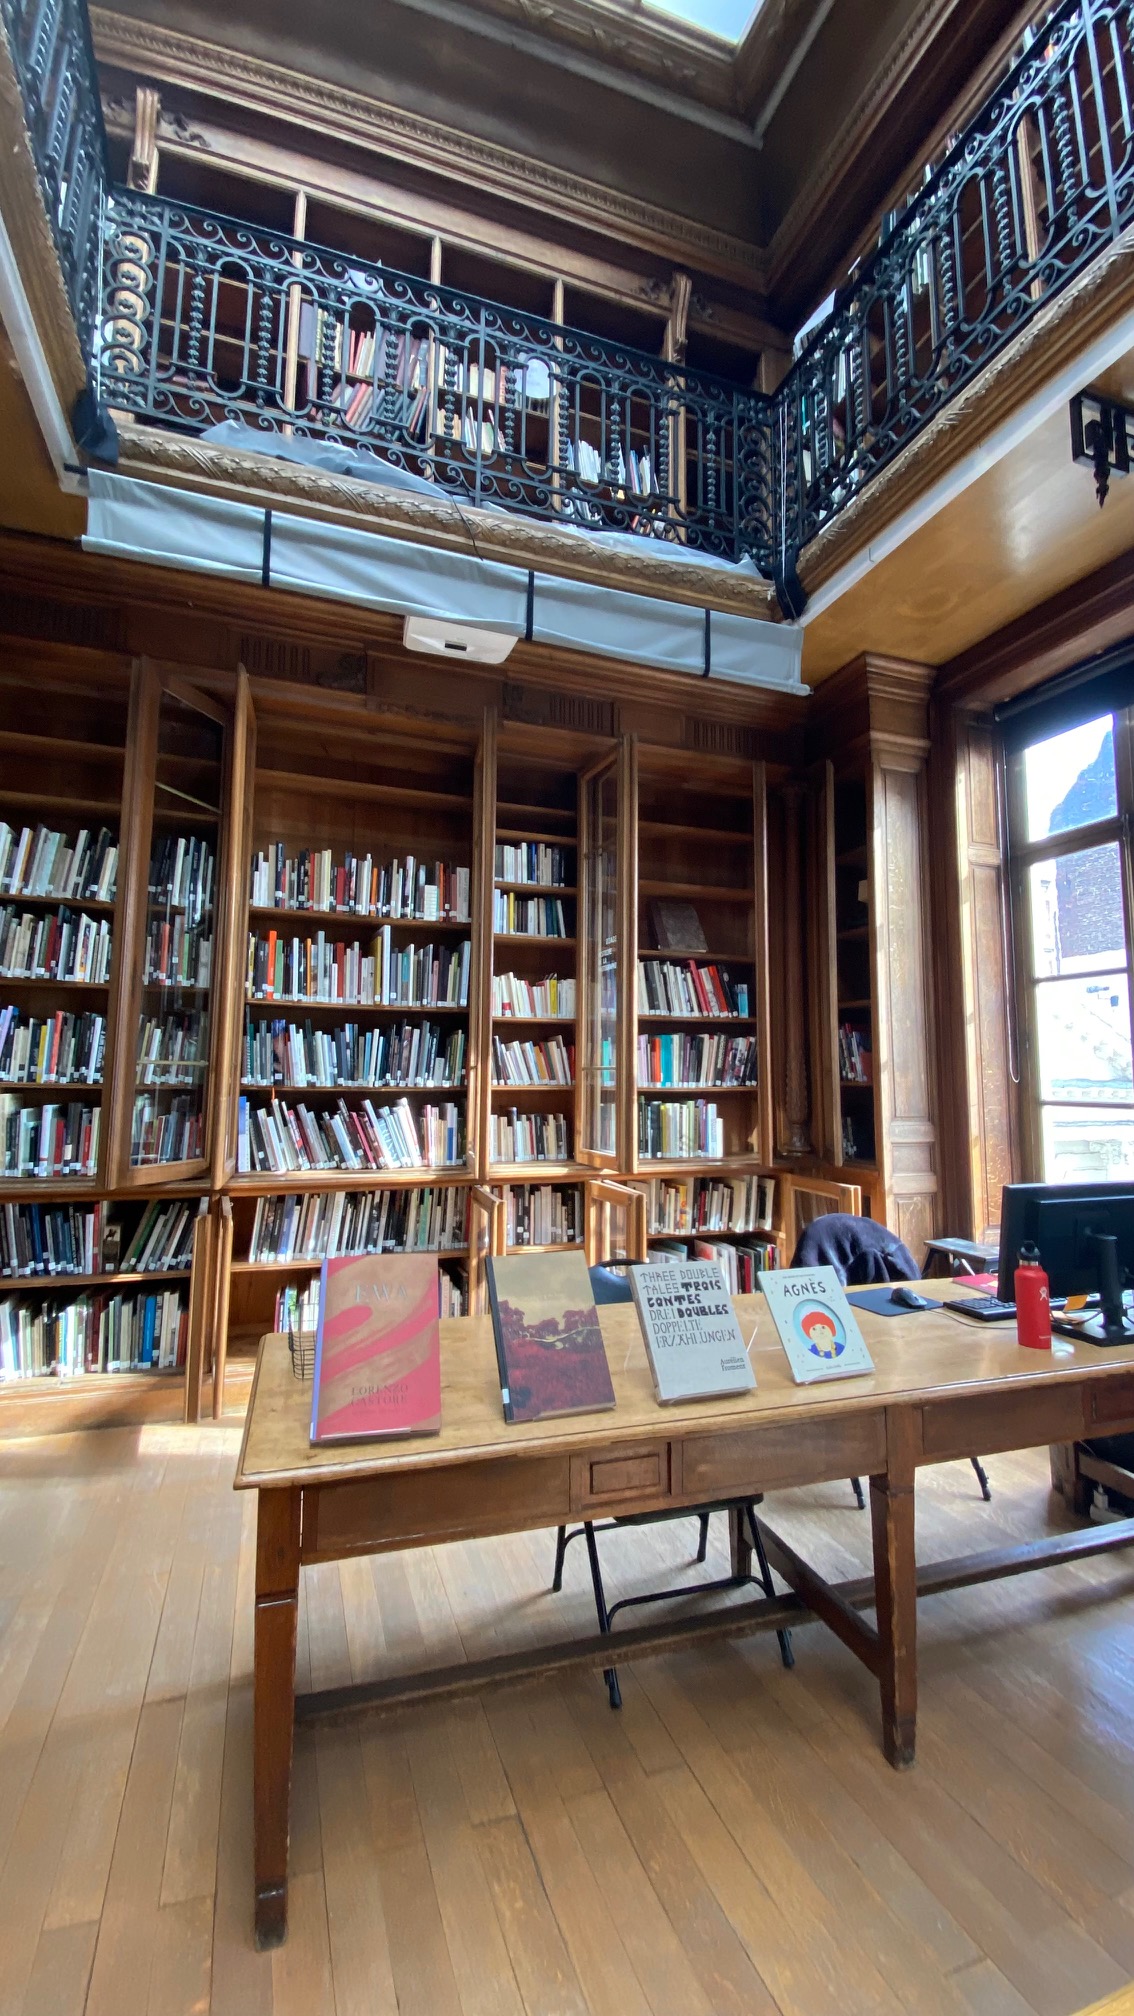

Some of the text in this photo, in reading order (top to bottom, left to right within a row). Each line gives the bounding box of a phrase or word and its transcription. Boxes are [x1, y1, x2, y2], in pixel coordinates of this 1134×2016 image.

[640, 1267, 720, 1282] THREE DOUBLE
[643, 1280, 721, 1296] TALES TROIS
[783, 1278, 826, 1297] AGNÈS
[647, 1293, 702, 1308] CONTES
[649, 1304, 729, 1321] DREI DOUBLES
[652, 1319, 703, 1335] DOPPELTE
